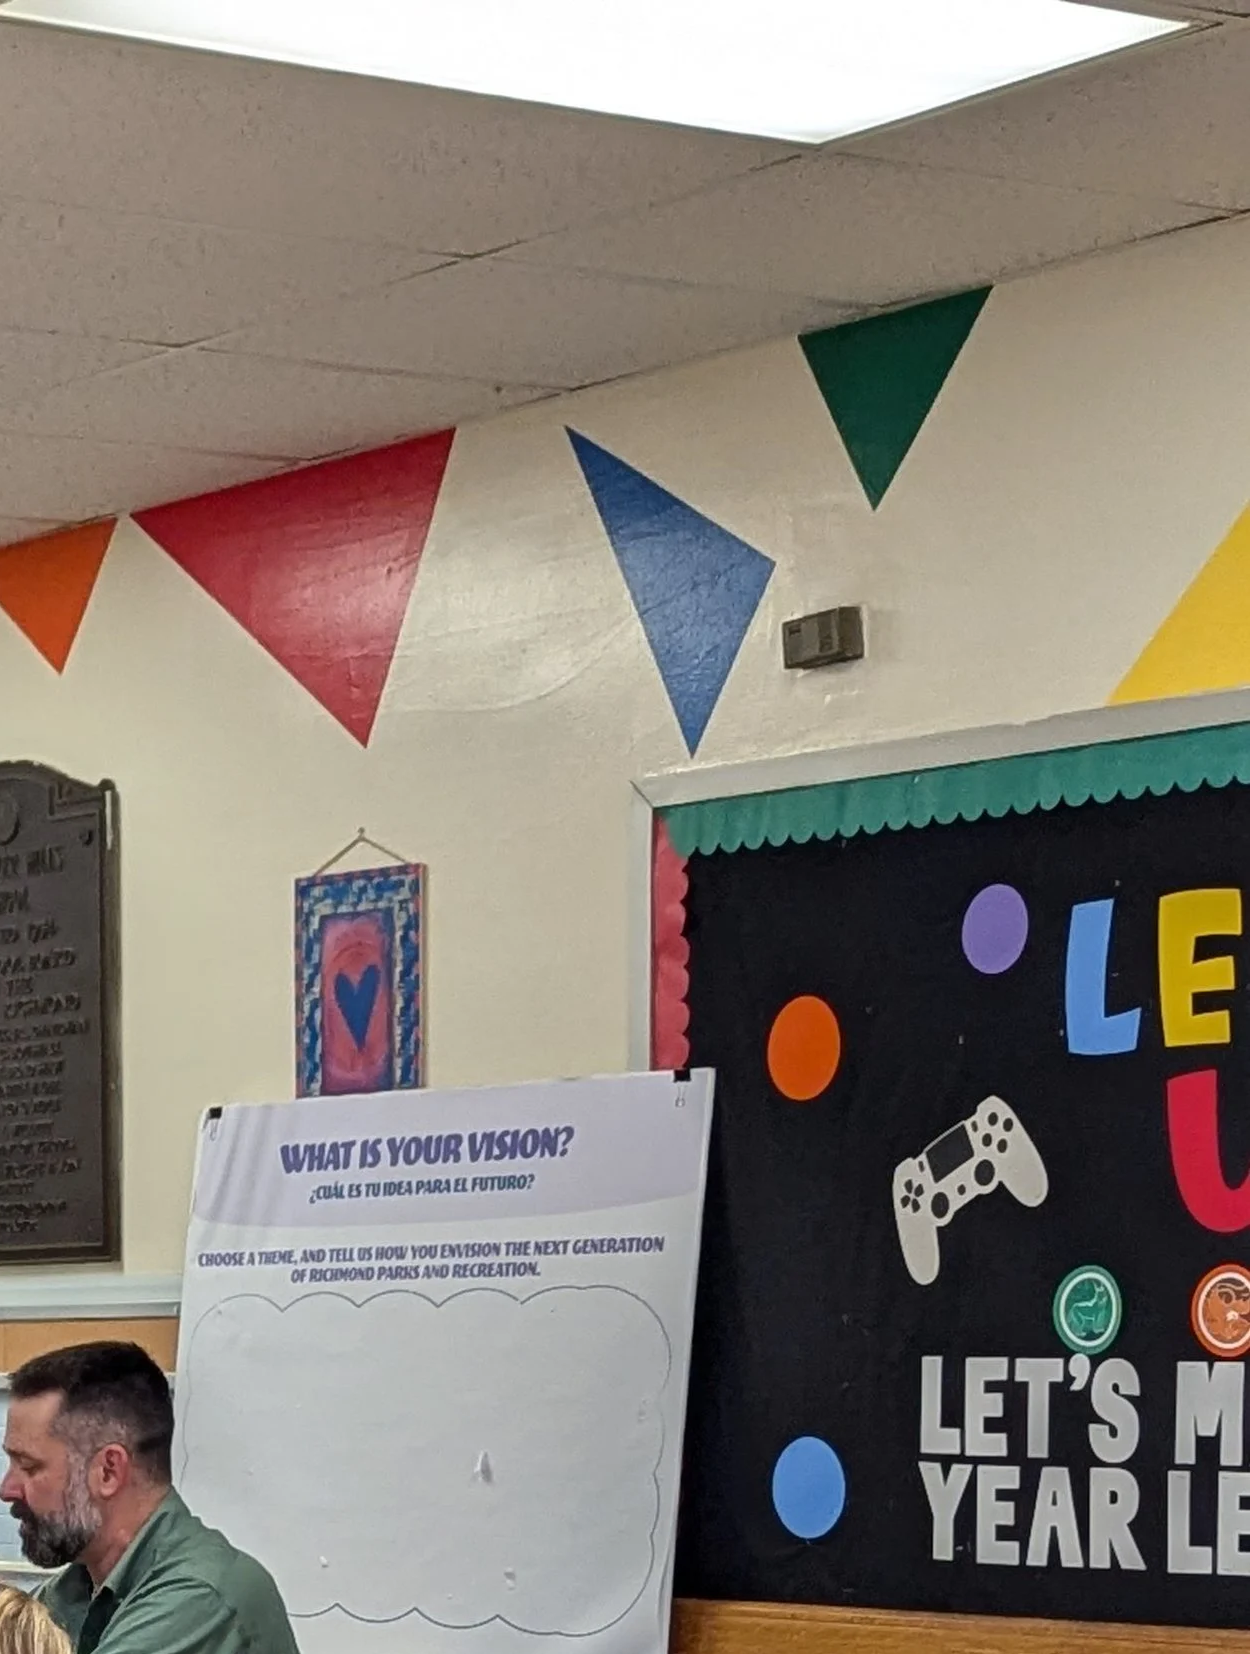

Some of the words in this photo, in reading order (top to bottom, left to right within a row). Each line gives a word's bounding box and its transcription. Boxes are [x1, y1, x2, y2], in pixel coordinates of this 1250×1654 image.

[1065, 888, 1242, 1056] LE
[280, 1139, 356, 1174] WHAT
[359, 1137, 382, 1169] IS
[387, 1133, 463, 1167] YOUR
[467, 1126, 575, 1163] VISION?
[348, 1182, 362, 1198] ES
[365, 1181, 381, 1197] TU
[383, 1179, 413, 1196] IDEA
[415, 1178, 451, 1195] PARA
[453, 1177, 468, 1193] EL
[471, 1173, 535, 1192] FUTURO?
[198, 1251, 244, 1267] CHOOSE
[247, 1251, 255, 1265] A
[257, 1250, 298, 1266] THEME,
[300, 1249, 326, 1264] AND
[328, 1247, 356, 1263] TELL
[357, 1246, 373, 1261] US
[375, 1245, 409, 1261] HOW
[410, 1244, 438, 1259] YOU
[440, 1241, 501, 1259] ENVISION
[504, 1240, 531, 1257] THE
[533, 1239, 570, 1256] NEXT
[572, 1236, 665, 1254] GENERATION
[291, 1269, 307, 1283] OF
[309, 1267, 375, 1283] RICHMOND
[377, 1265, 420, 1281] PARKS
[421, 1263, 450, 1279] AND
[452, 1261, 541, 1279] RECREATION.
[919, 1353, 1141, 1464] LET'S
[918, 1461, 1147, 1571] YEAR
